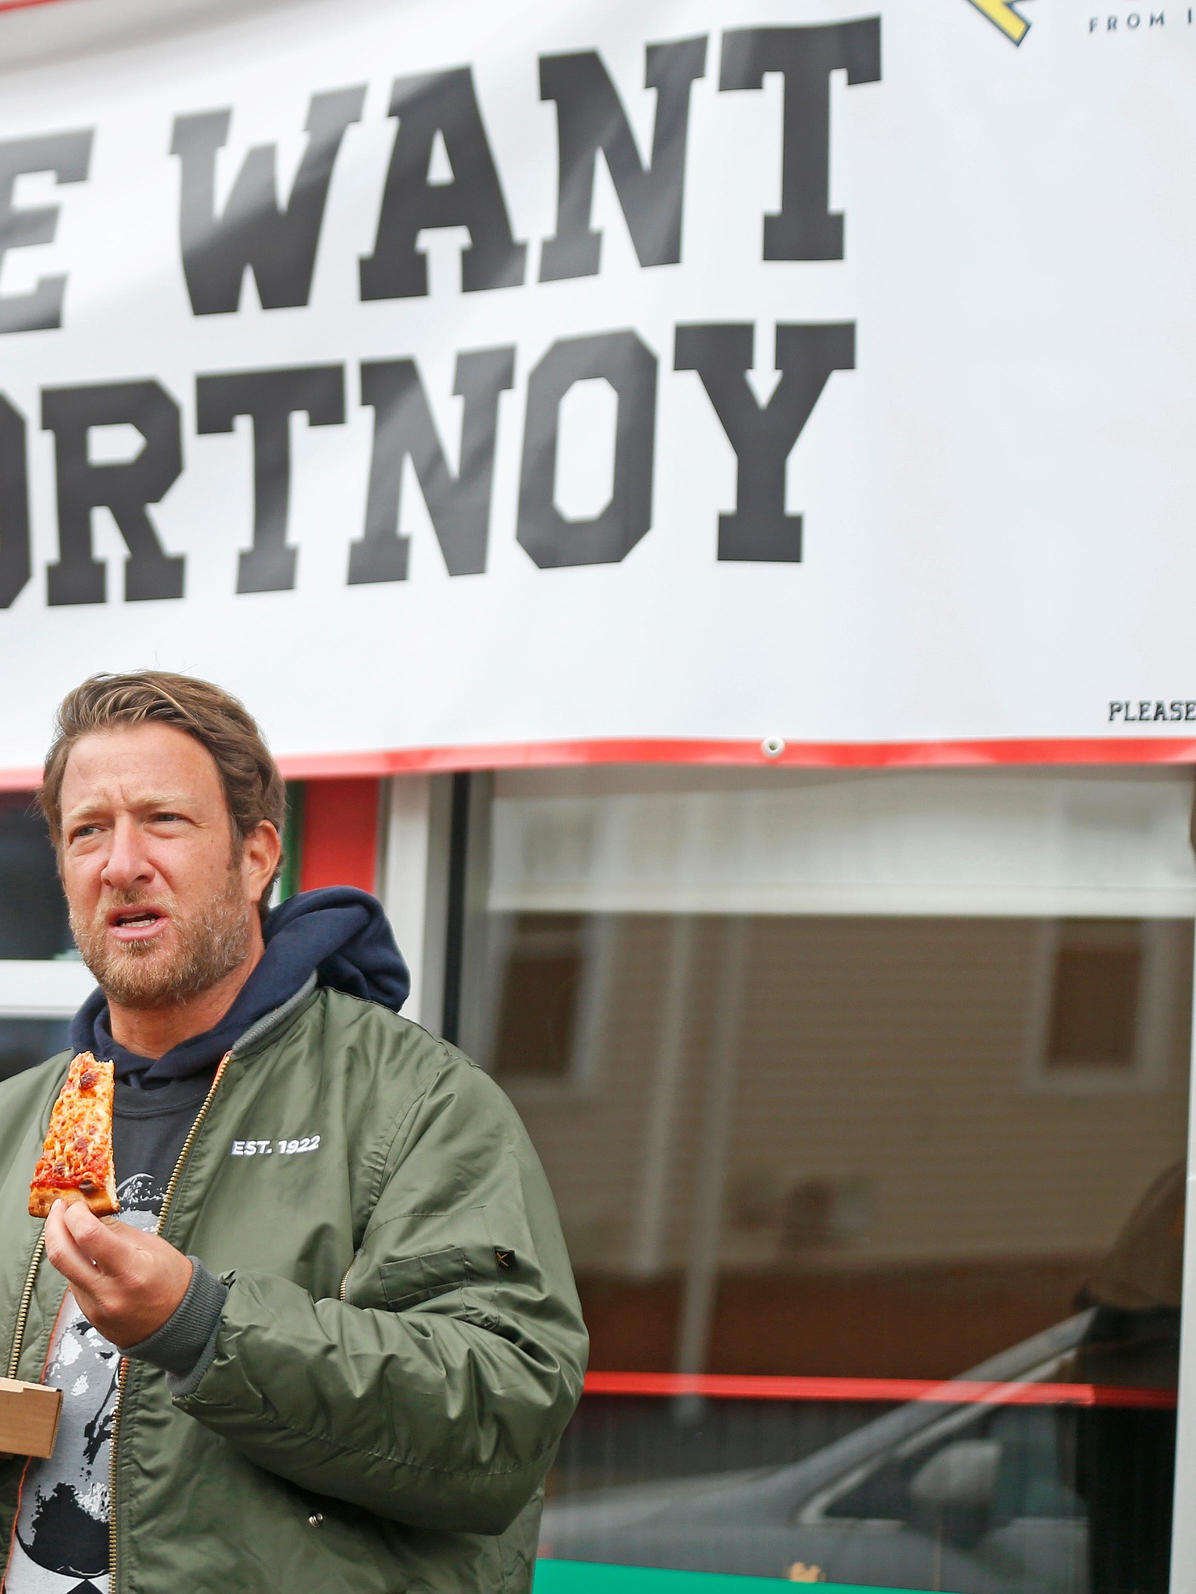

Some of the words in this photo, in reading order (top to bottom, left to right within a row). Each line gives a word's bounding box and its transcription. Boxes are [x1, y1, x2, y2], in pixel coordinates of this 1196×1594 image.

[1088, 9, 1165, 33] FROM
[168, 13, 883, 317] WANT
[1108, 699, 1196, 721] PLEASE
[231, 1139, 273, 1156] EST.
[278, 1135, 321, 1155] 1922
